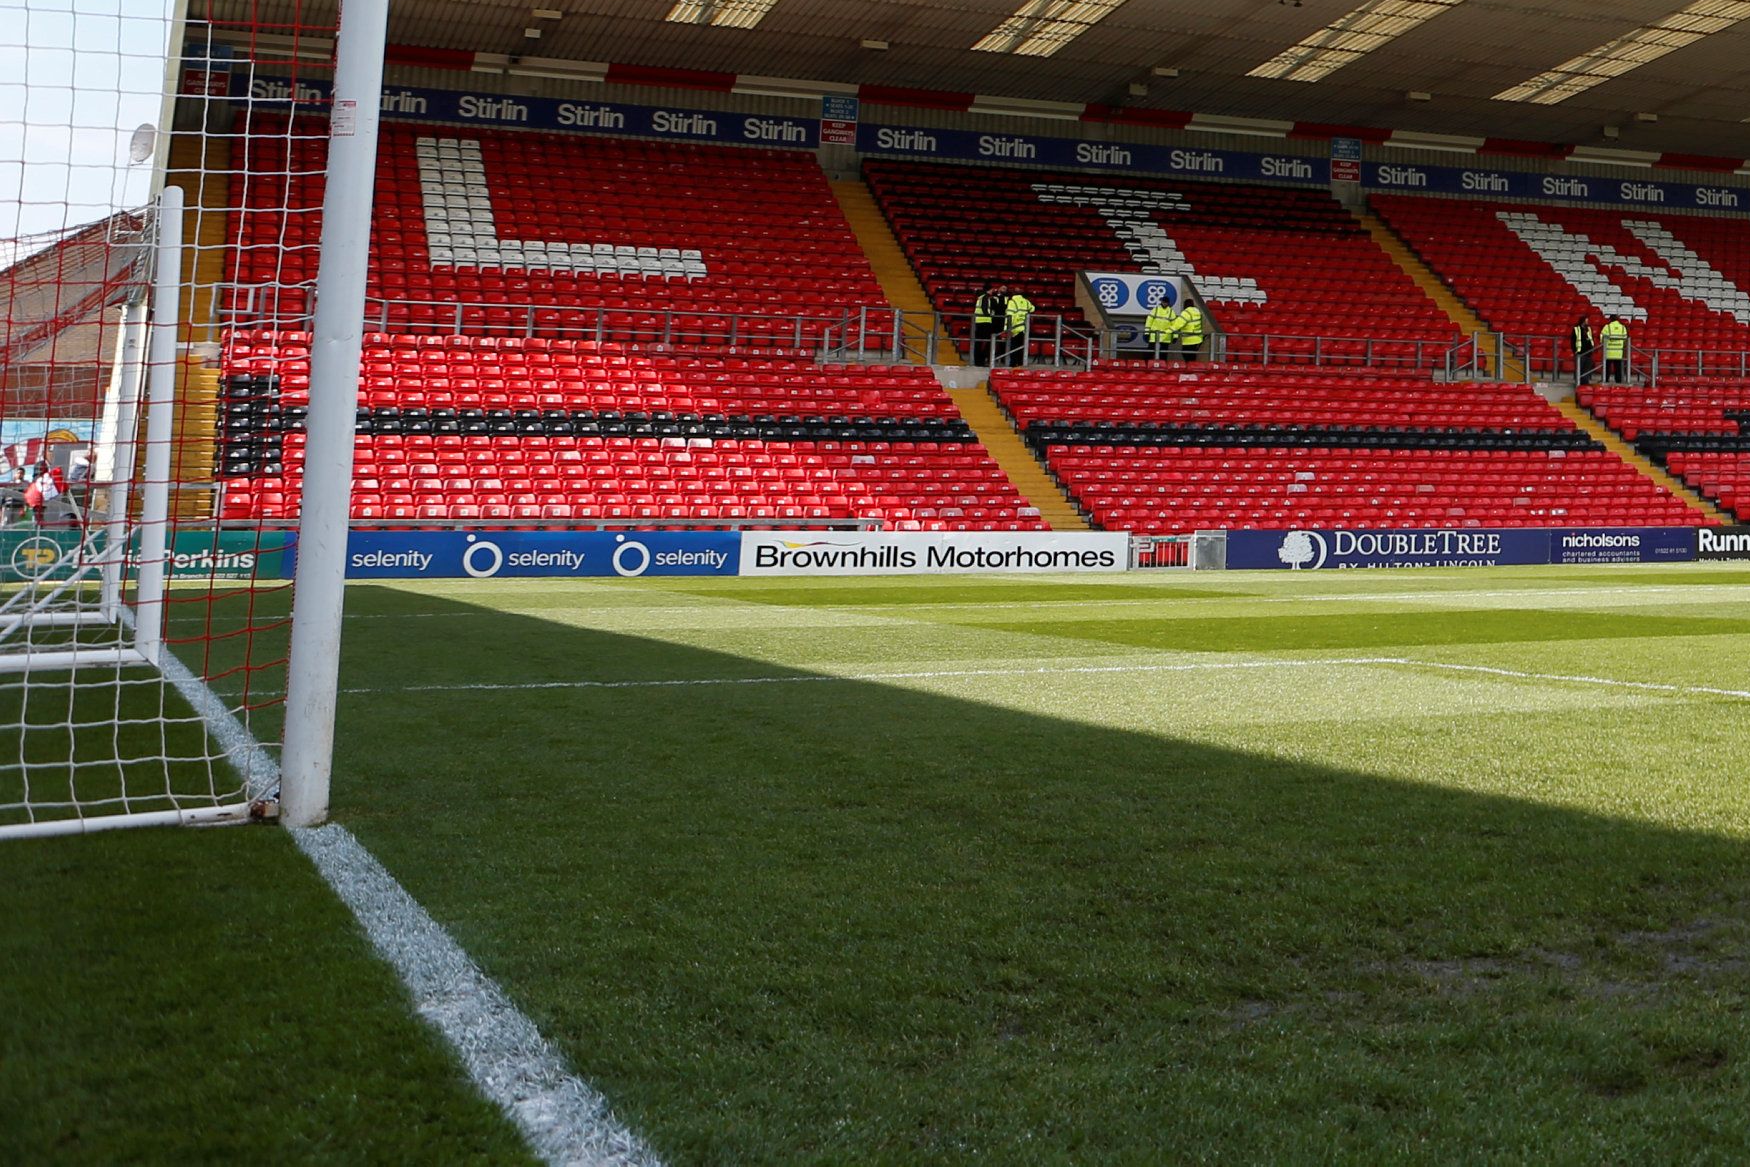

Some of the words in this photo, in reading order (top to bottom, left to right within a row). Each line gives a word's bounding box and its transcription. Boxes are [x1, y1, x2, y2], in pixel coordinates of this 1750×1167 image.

[251, 79, 322, 106] Stirlin
[458, 95, 528, 122] Stirlin
[557, 103, 624, 129] Stirlin
[652, 111, 717, 136] Stirlin
[743, 118, 806, 142] Stirlin
[877, 128, 937, 152] Stirlin
[978, 135, 1036, 159] Stirlin
[1076, 143, 1131, 165] Stirlin
[1170, 150, 1223, 173] Stirlin
[1261, 157, 1312, 178] Stirlin
[1378, 166, 1427, 187] Stirlin
[1462, 171, 1509, 192] Stirlin
[1542, 177, 1588, 198] Stirlin
[1620, 183, 1664, 203] Stirlin
[1695, 188, 1738, 207] Stirlin
[1562, 533, 1640, 548] nicholsons
[351, 549, 433, 570] selenity
[508, 549, 585, 569] selenity
[655, 548, 729, 568] selenity
[755, 545, 916, 568] Brownhills
[927, 545, 1115, 567] Motorhomes
[1562, 550, 1596, 558] chartered
[1599, 549, 1640, 557] accountants
